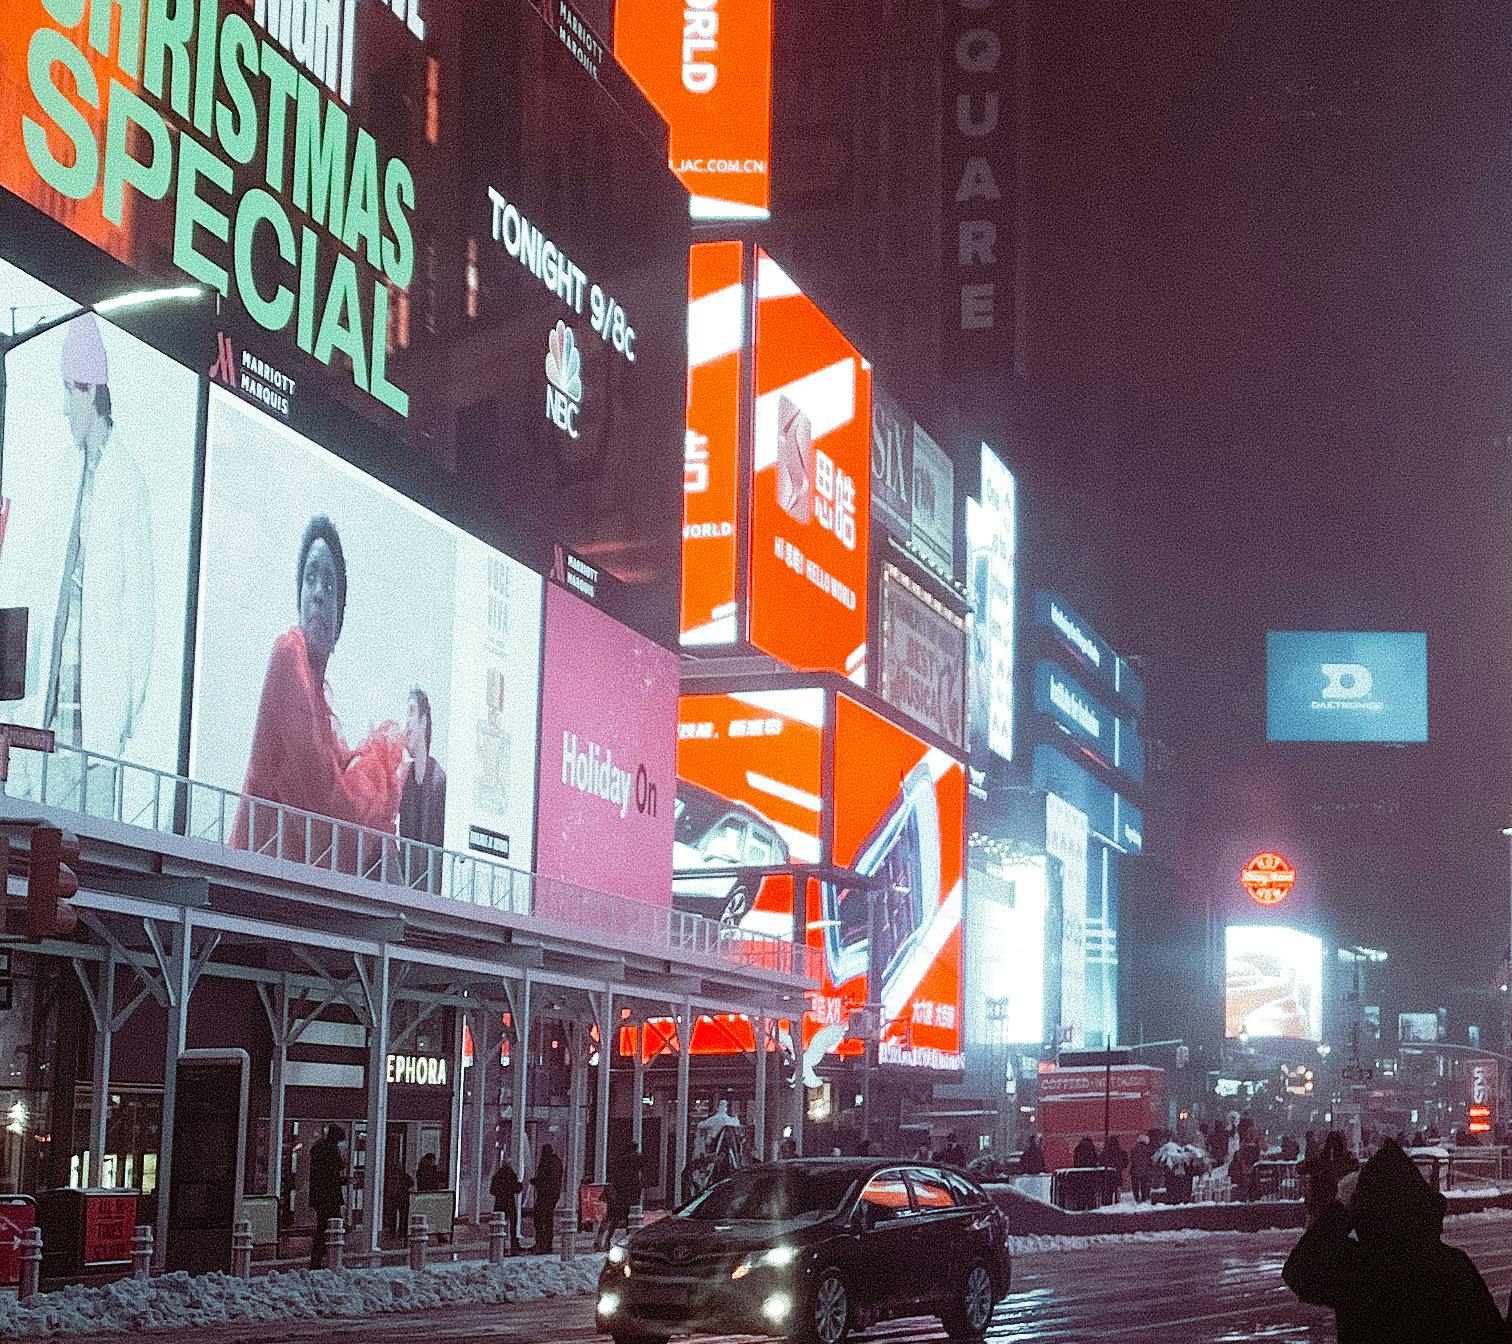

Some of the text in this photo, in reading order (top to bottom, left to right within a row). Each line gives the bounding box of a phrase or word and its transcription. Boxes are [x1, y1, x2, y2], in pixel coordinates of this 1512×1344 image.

[21, 25, 411, 420] SPECIAL
[487, 184, 588, 314] TONIGHT
[241, 374, 290, 415] MARQUIS
[242, 350, 296, 396] MARRIOTT
[544, 367, 583, 440] NBC
[561, 729, 659, 819] Holiday On
[386, 1054, 447, 1085] EPHORA
